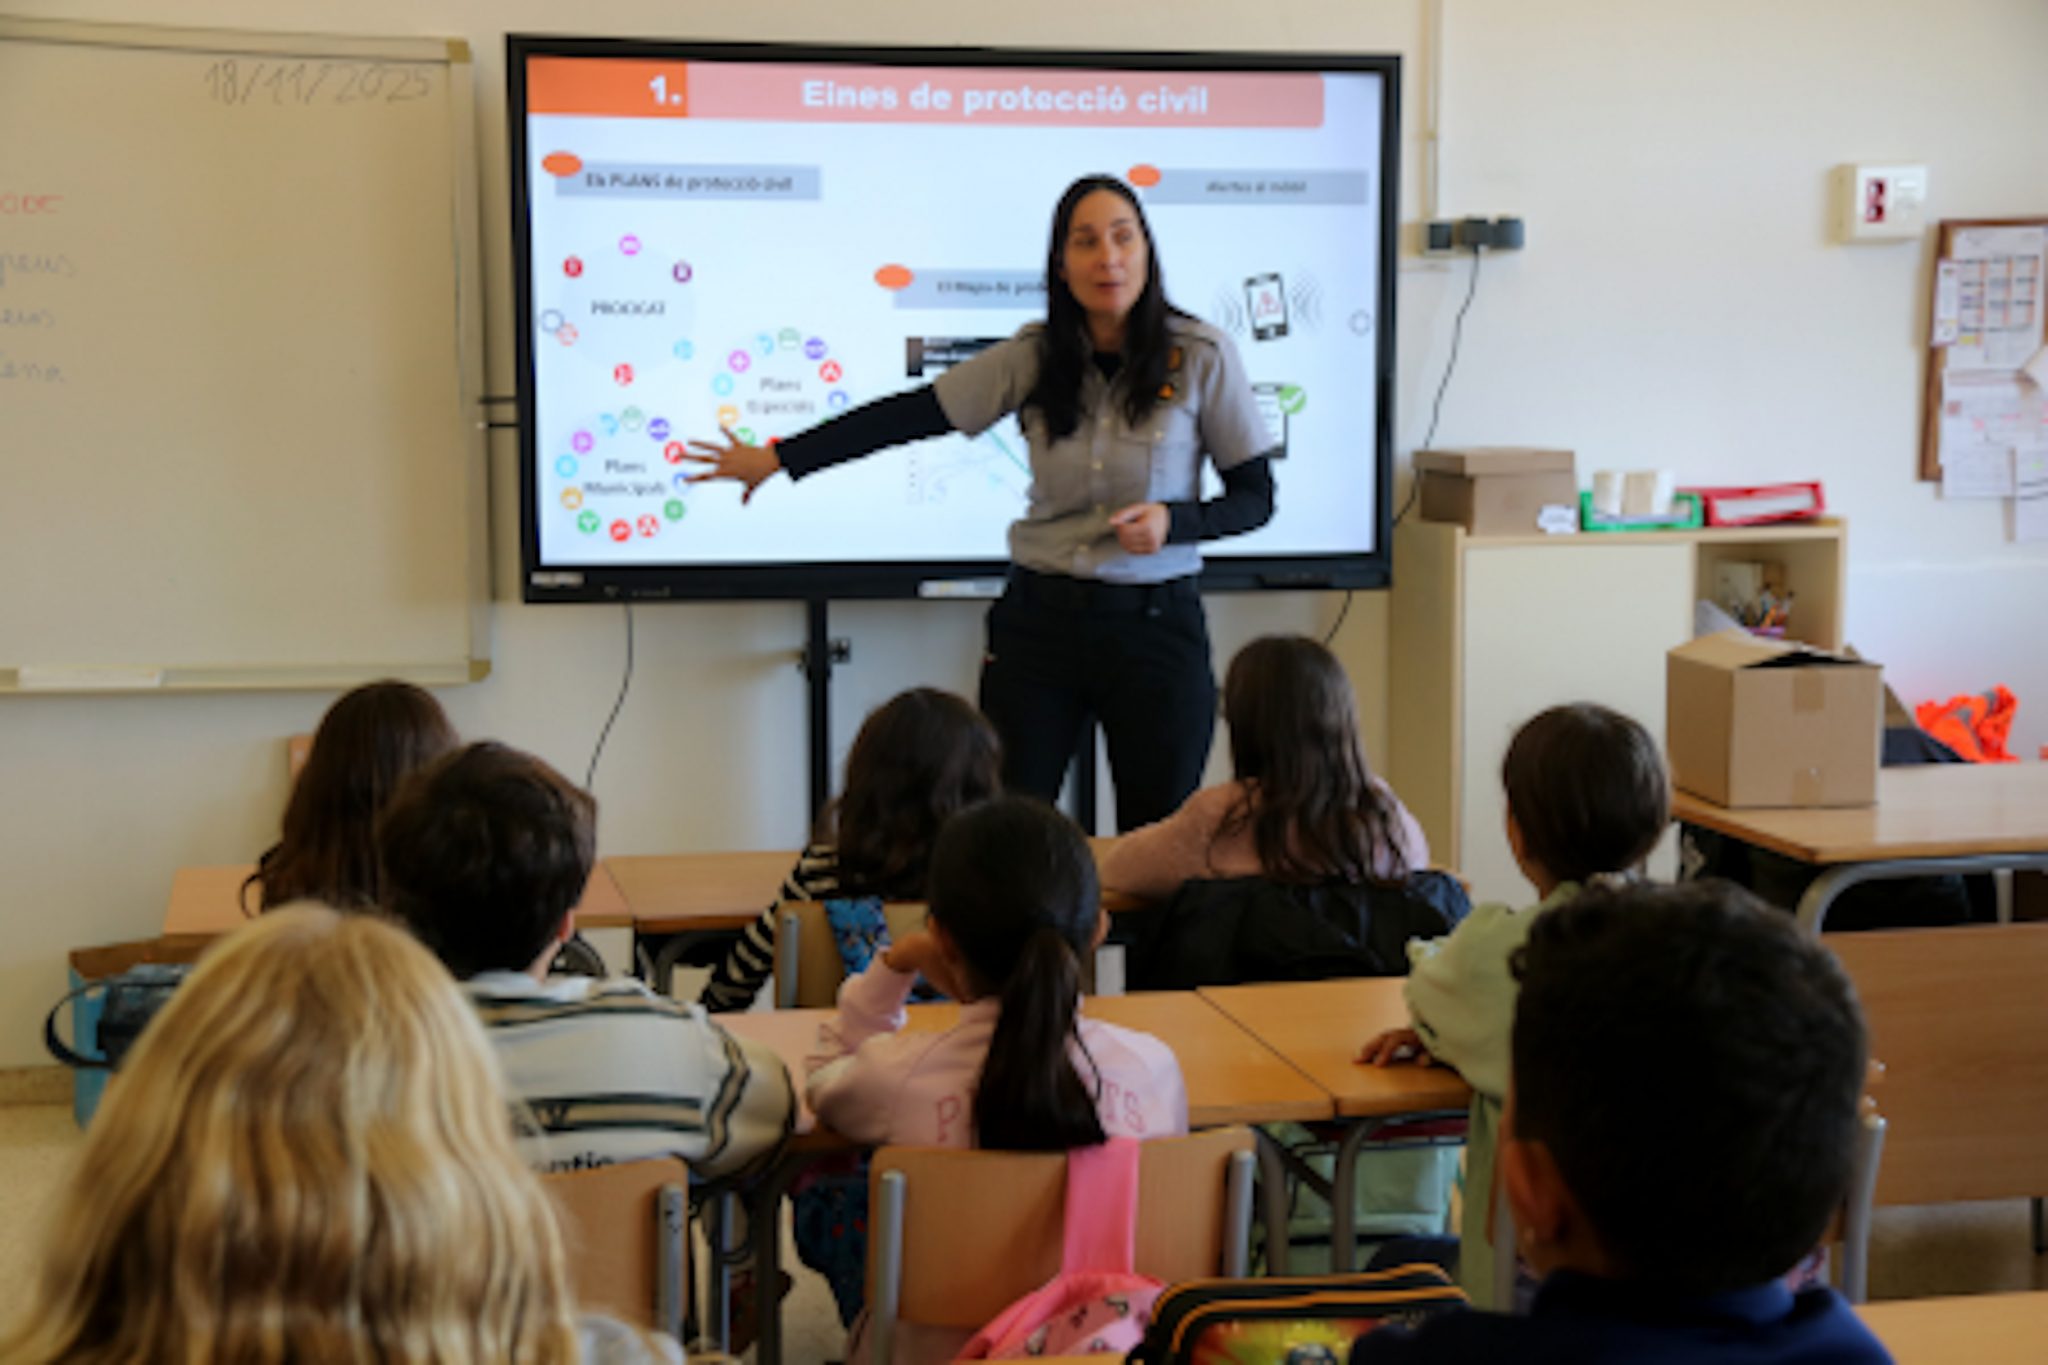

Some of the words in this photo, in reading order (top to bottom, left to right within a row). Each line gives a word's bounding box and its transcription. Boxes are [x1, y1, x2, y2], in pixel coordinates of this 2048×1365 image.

[203, 58, 431, 106] 18/11/2025
[649, 75, 682, 105] 1.
[801, 80, 898, 110] Eines
[909, 82, 952, 111] de
[963, 82, 1127, 116] protecció
[1138, 86, 1209, 114] civil
[664, 173, 682, 189] de
